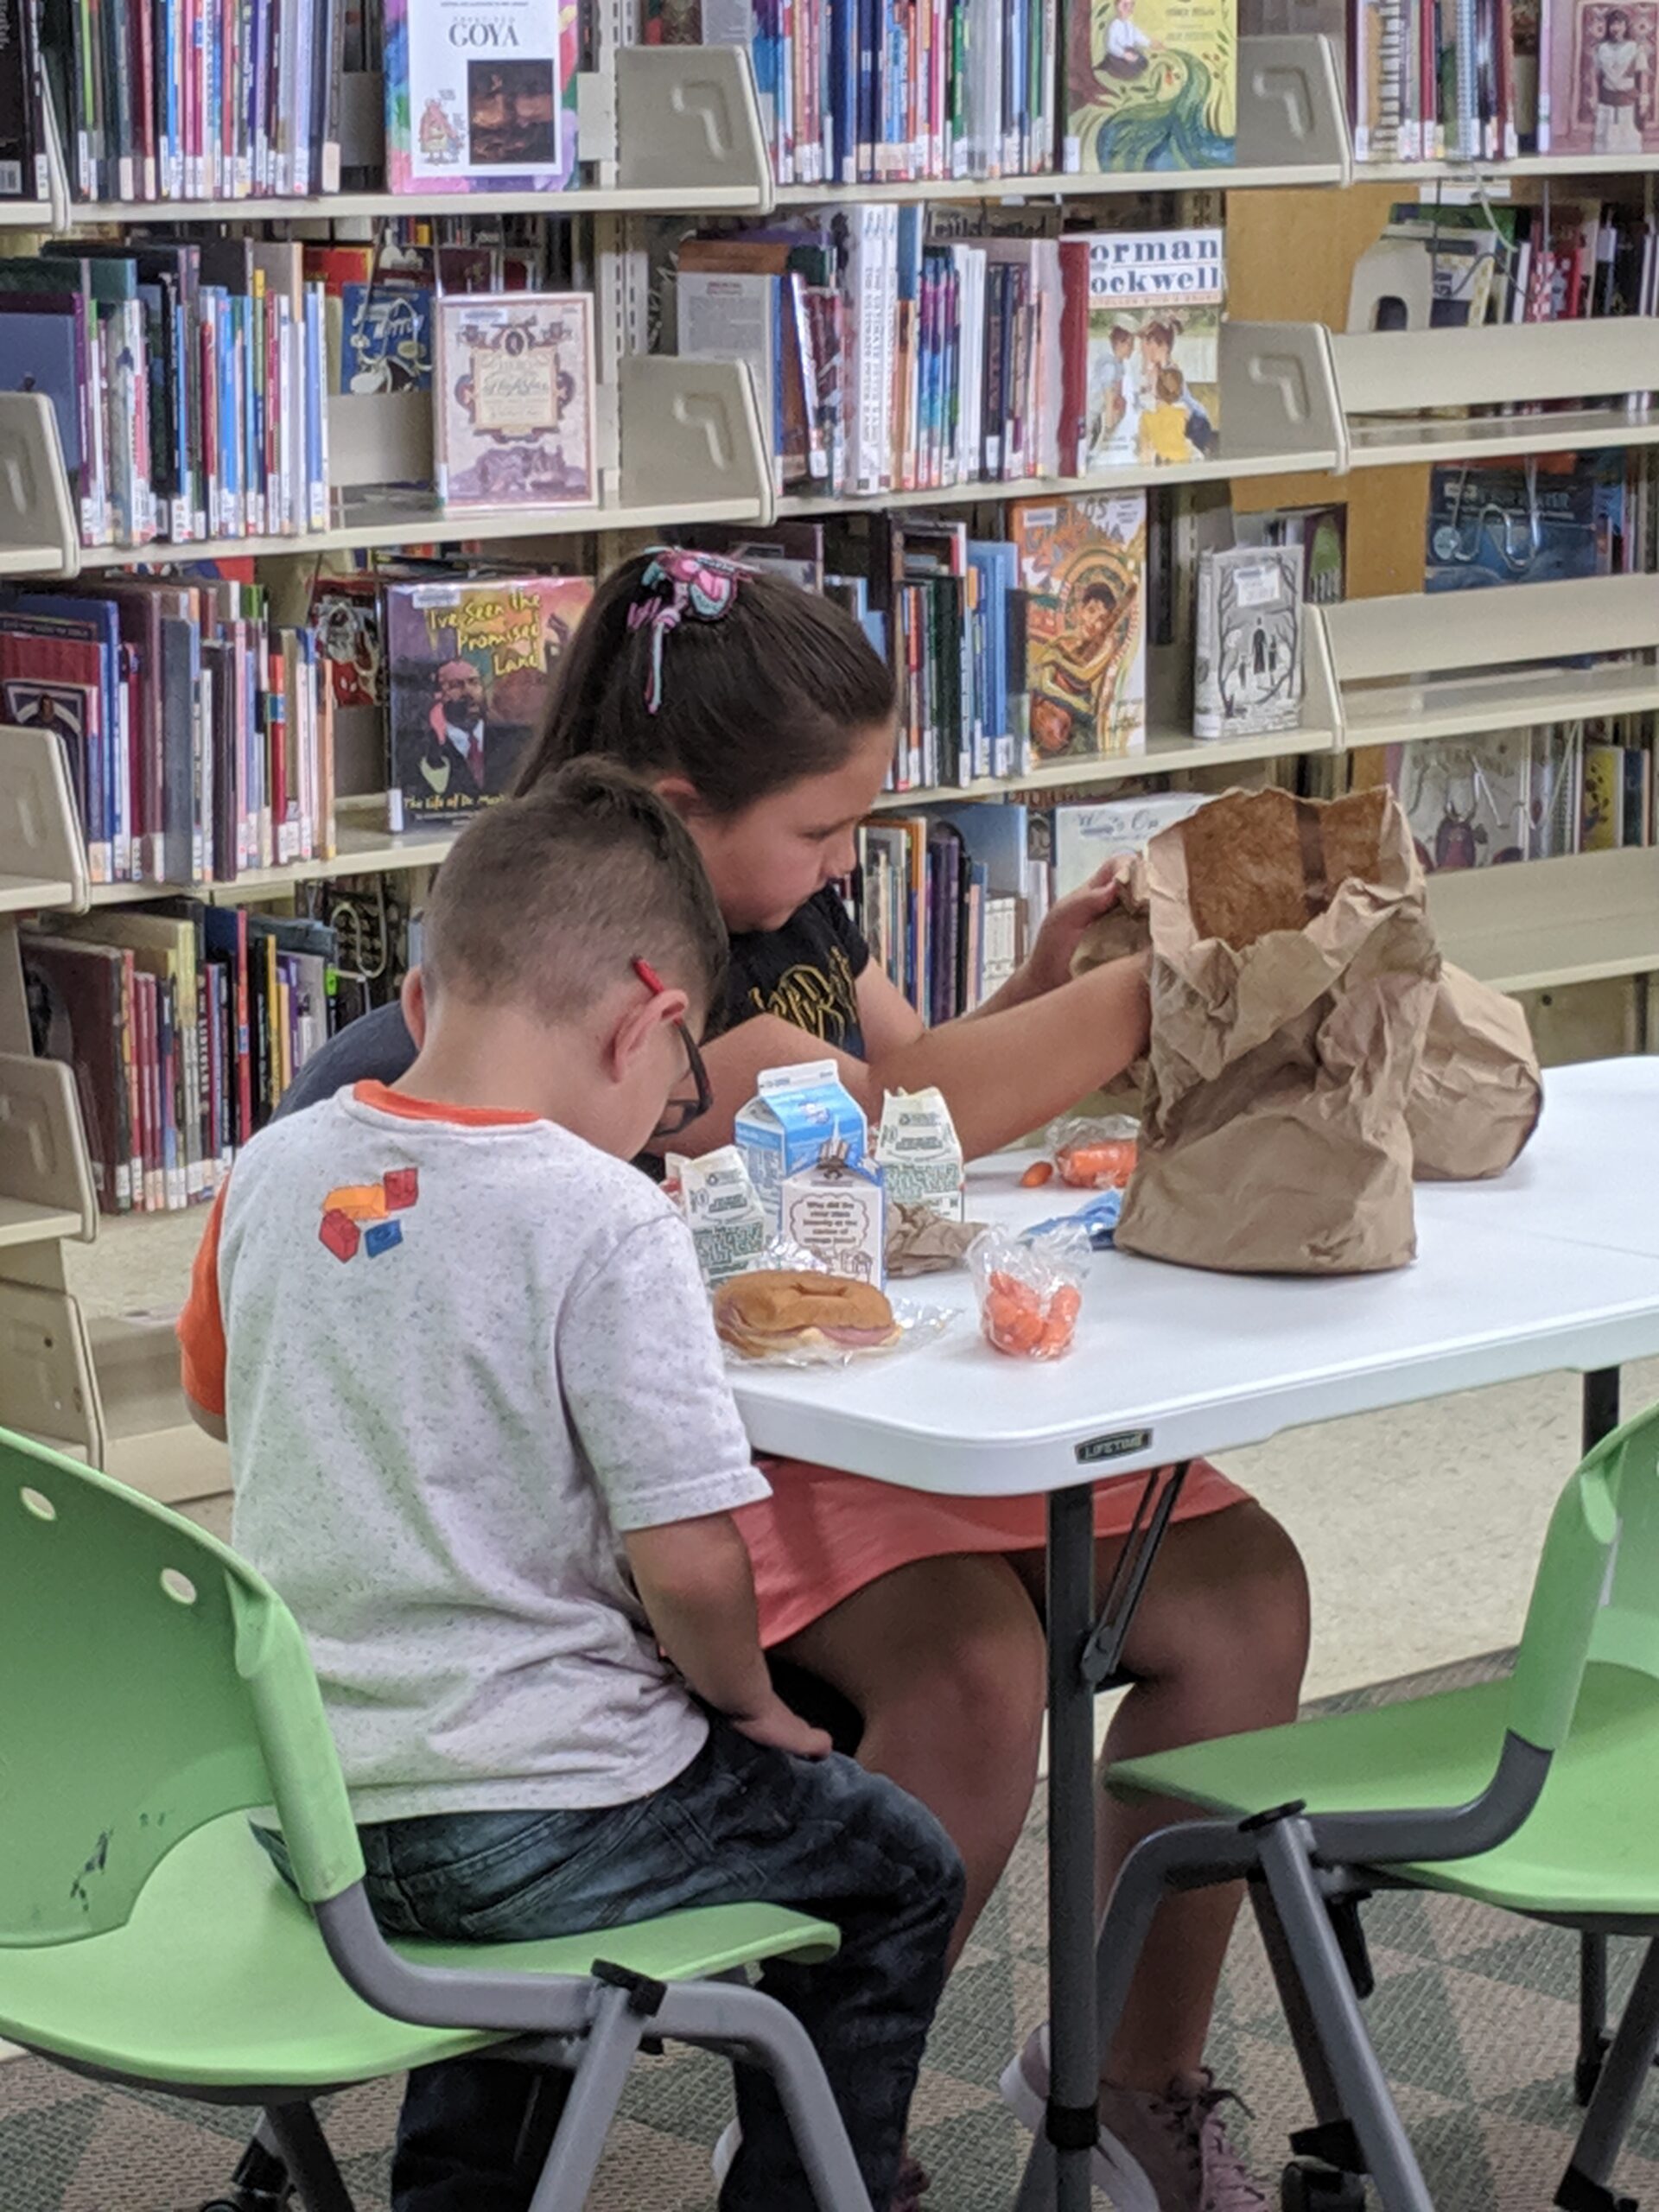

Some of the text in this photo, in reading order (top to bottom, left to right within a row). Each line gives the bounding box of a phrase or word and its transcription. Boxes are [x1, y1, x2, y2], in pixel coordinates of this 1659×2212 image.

[448, 22, 520, 48] GOYA
[1090, 238, 1219, 264] orman
[1090, 266, 1219, 295] ockwell
[464, 601, 505, 626] Seen
[455, 611, 541, 655] Promised
[493, 641, 543, 677] Land
[446, 792, 459, 810] of
